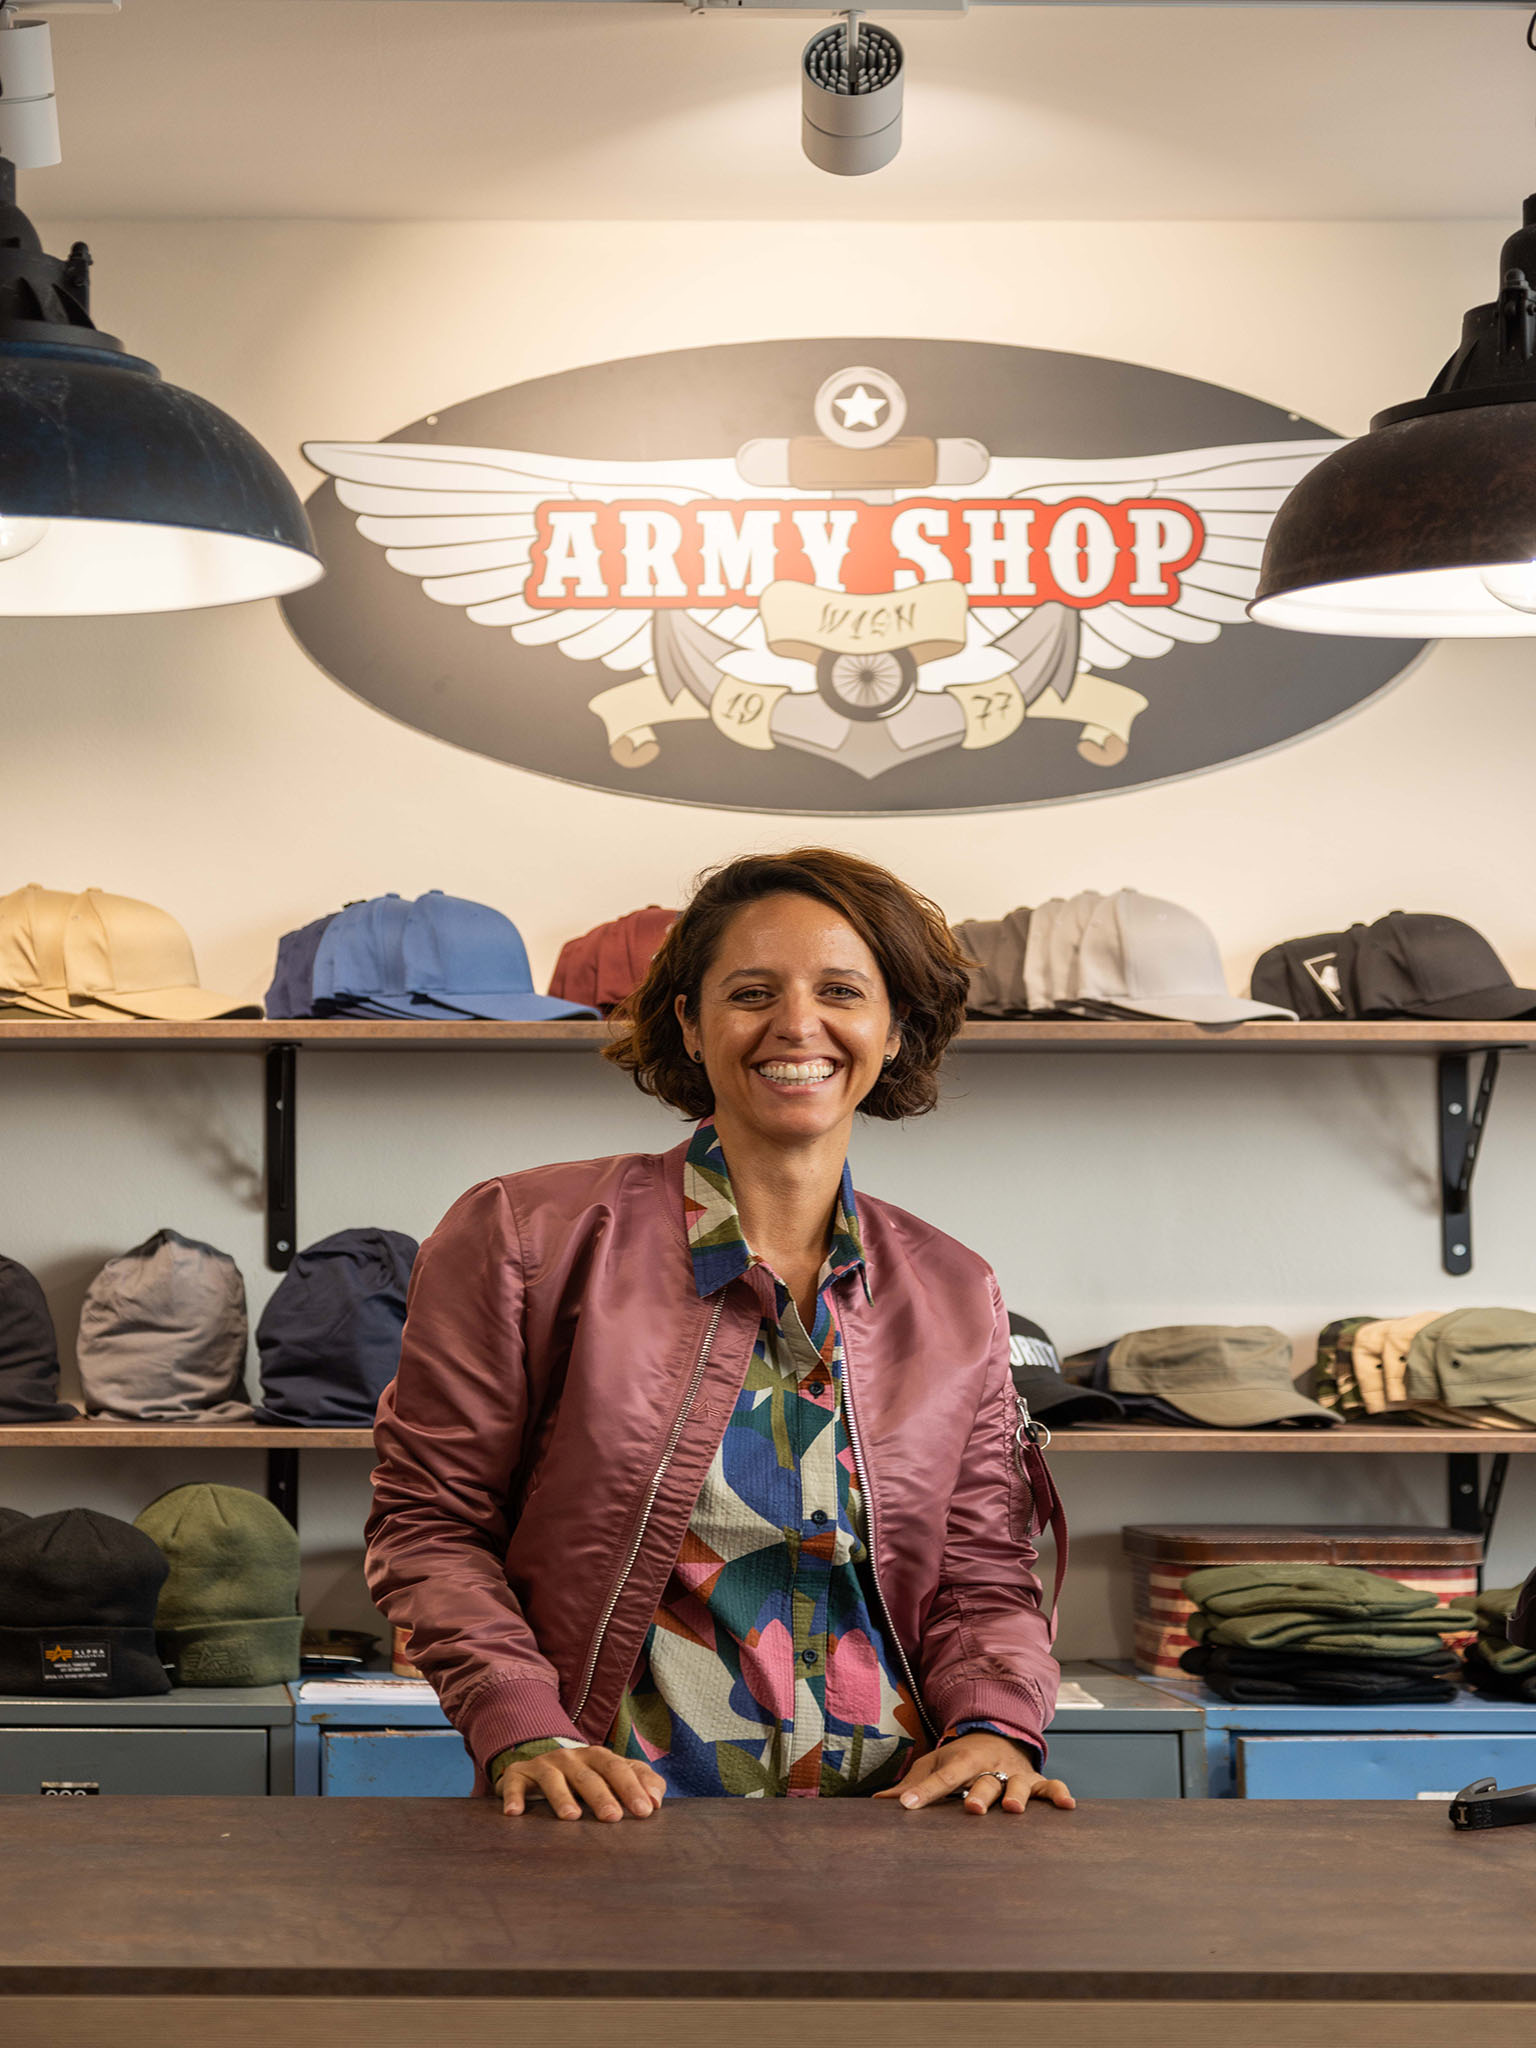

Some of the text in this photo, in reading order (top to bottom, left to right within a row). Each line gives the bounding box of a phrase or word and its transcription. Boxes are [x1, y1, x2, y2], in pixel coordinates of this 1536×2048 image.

[539, 507, 1194, 597] ARMY SHOP
[721, 691, 1013, 731] 19 77
